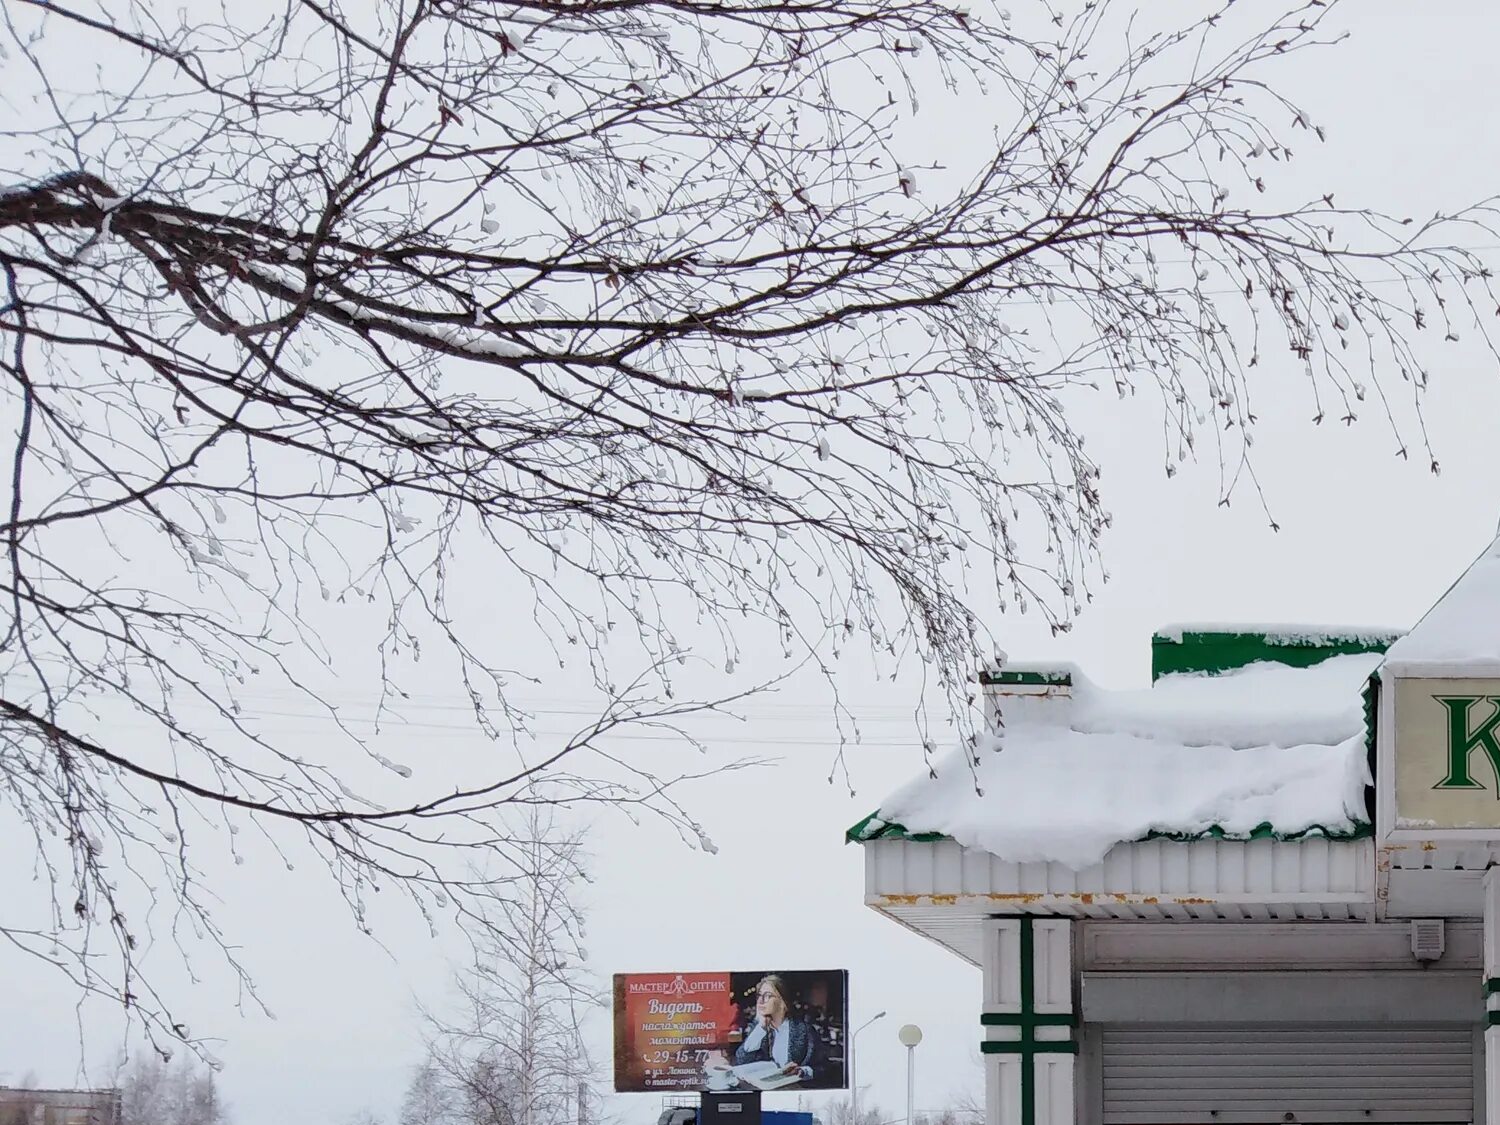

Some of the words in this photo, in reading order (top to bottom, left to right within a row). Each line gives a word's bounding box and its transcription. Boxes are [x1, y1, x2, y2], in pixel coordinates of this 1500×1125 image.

[629, 983, 669, 992] МАСТЕР
[690, 981, 726, 991] ОПТИК
[648, 999, 702, 1020] Видеть
[653, 1049, 709, 1064] 29-15-77
